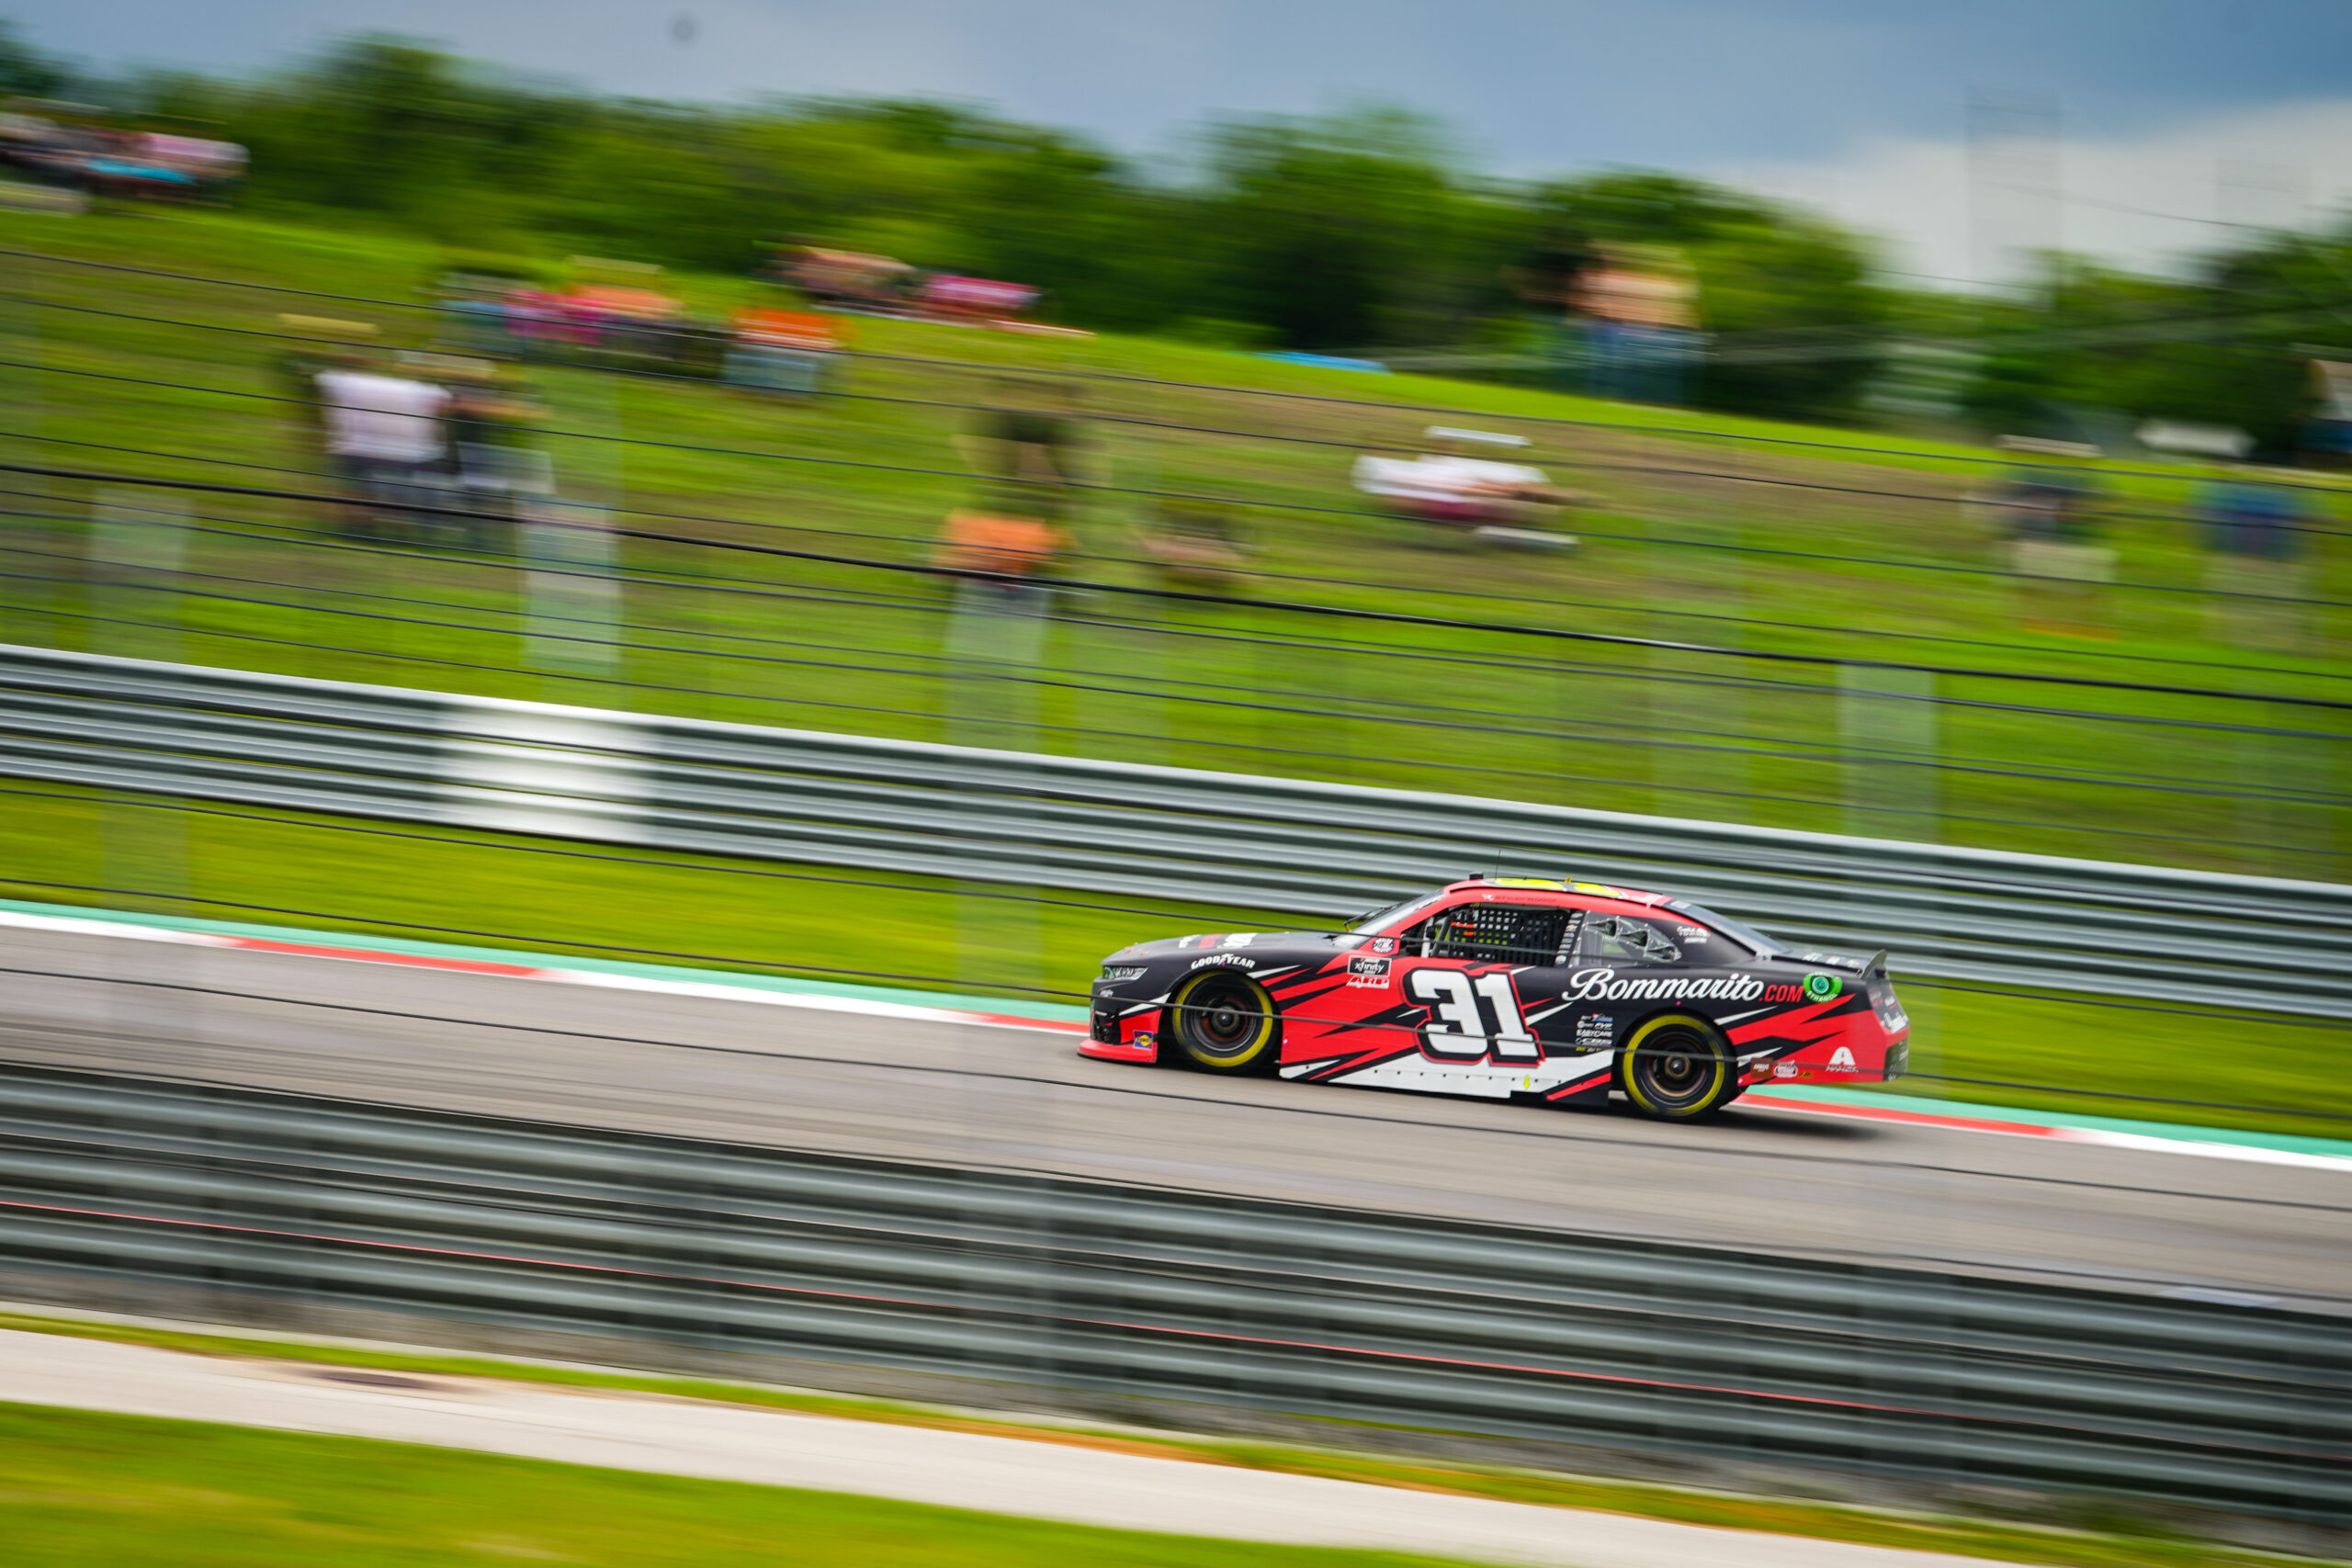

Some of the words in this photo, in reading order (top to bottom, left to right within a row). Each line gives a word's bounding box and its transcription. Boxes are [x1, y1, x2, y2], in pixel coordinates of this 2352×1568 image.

[1191, 953, 1256, 969] GOODYEAR
[1354, 960, 1385, 974] xfinity
[1411, 969, 1539, 1056] 31
